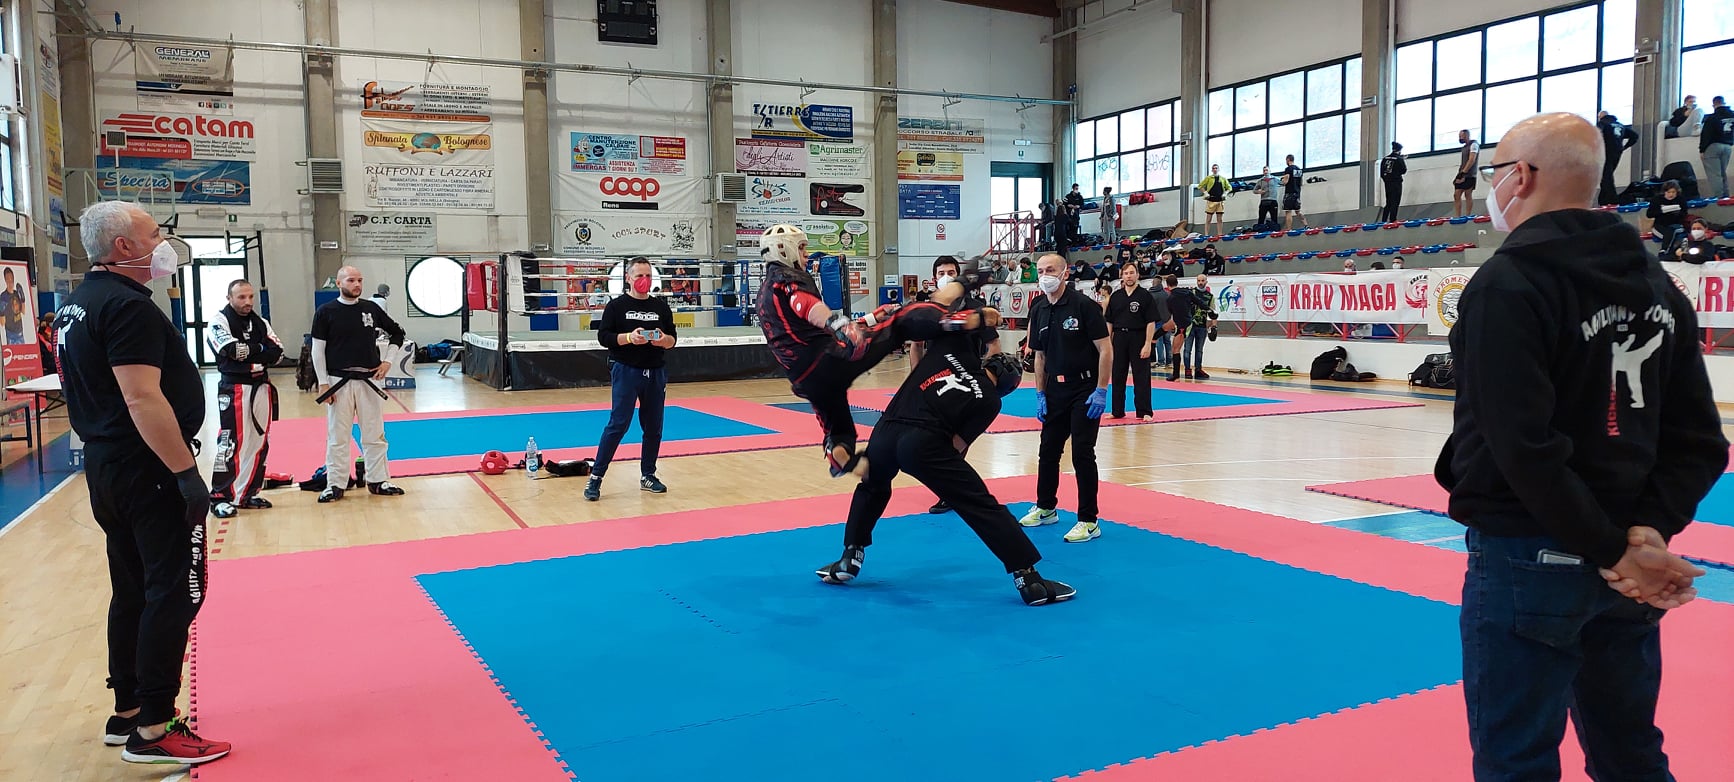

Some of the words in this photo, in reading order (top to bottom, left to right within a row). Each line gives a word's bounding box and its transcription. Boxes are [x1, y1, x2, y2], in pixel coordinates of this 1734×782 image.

[155, 47, 211, 59] GENERAL
[154, 115, 254, 139] catam
[443, 135, 489, 149] Bolognese
[820, 145, 864, 156] Agrimaster
[364, 166, 424, 177] RUFFONI
[429, 166, 436, 176] E
[440, 167, 493, 178] LAZZARI
[600, 176, 661, 201] coop
[371, 216, 392, 225] C.F.
[394, 216, 432, 225] CARTA
[612, 228, 633, 240] 100%
[634, 226, 667, 240] SPORT
[1436, 277, 1470, 294] PROMET
[1290, 283, 1334, 311] KRAV
[1338, 282, 1397, 311] MAGA
